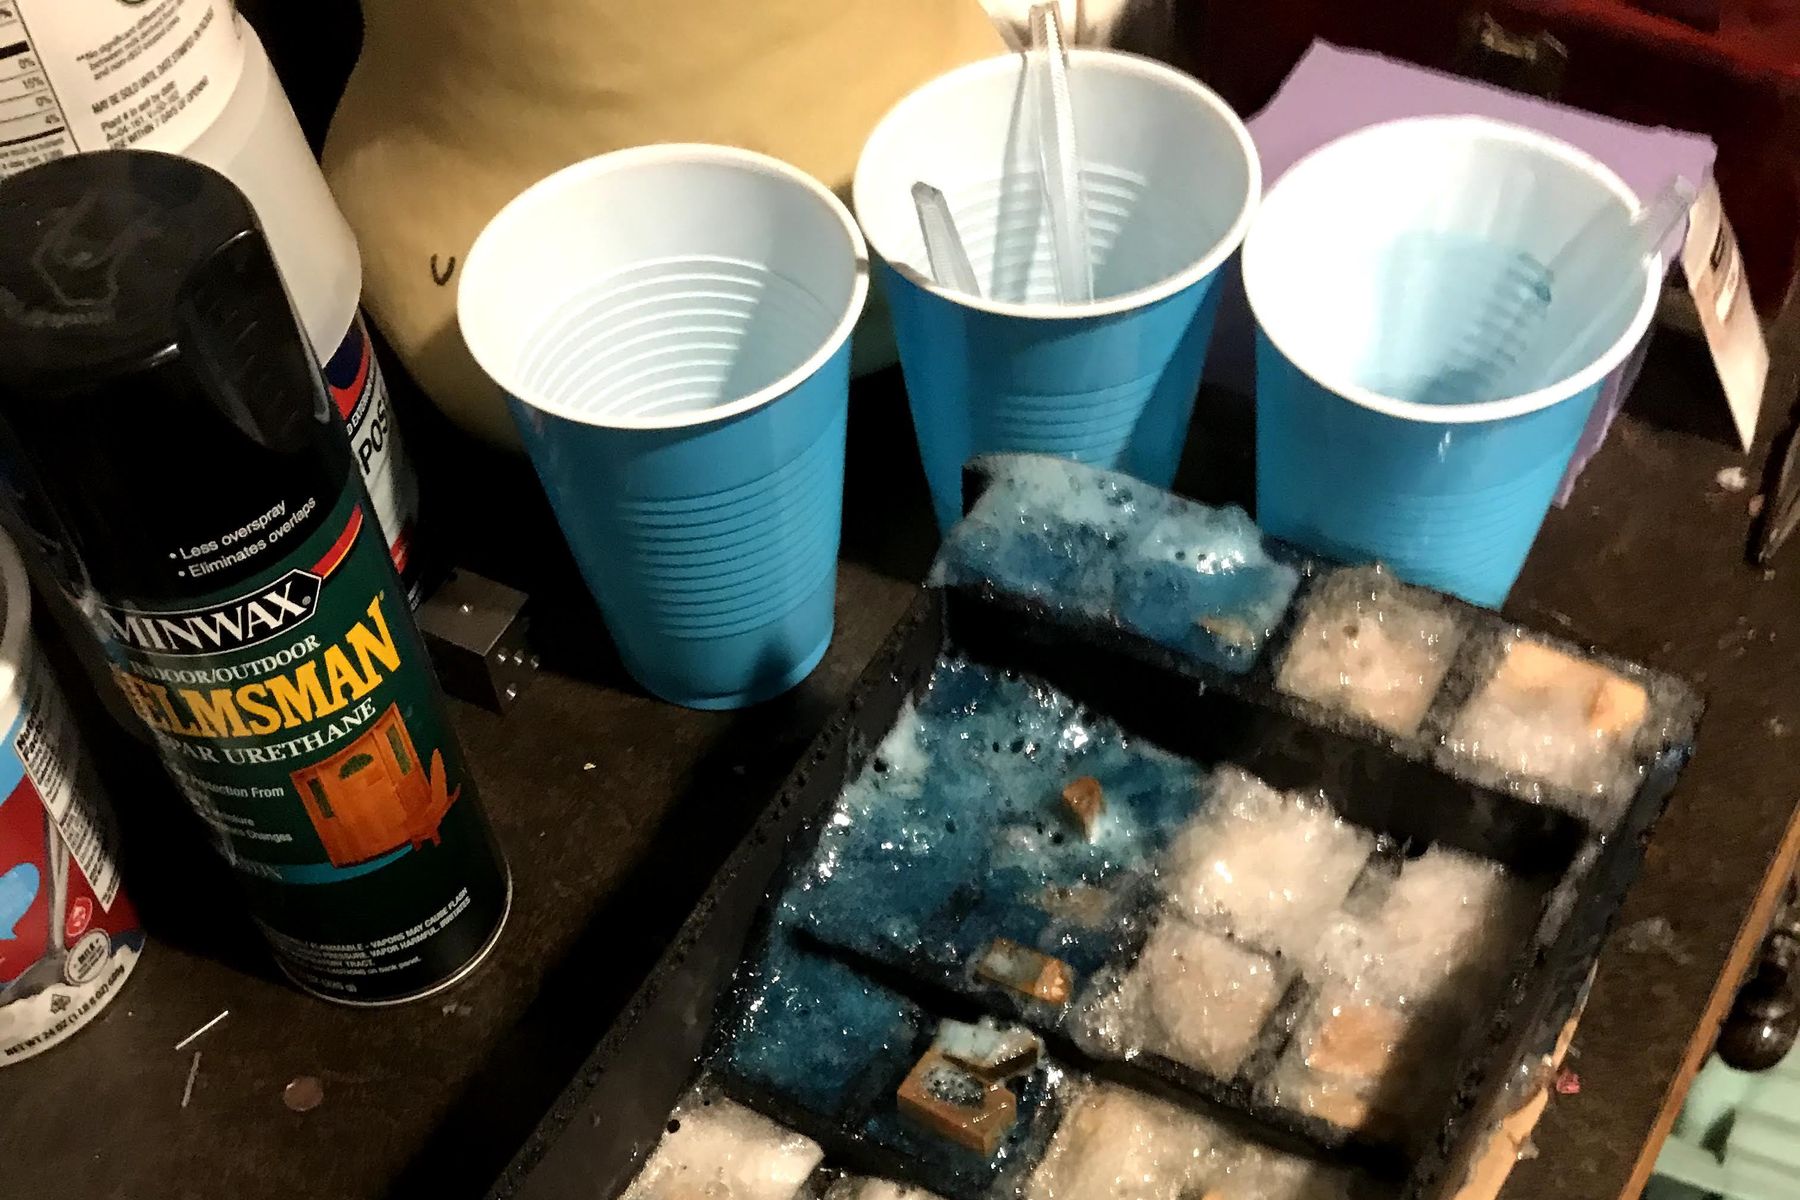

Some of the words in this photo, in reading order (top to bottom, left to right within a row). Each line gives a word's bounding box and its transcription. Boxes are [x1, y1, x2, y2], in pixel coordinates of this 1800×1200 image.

[120, 81, 139, 100] SOLD
[180, 540, 219, 560] Less
[221, 499, 286, 546] overspray
[188, 539, 267, 578] Eliminates
[269, 497, 316, 543] overlaps
[98, 581, 307, 651] MINWAX
[223, 696, 377, 765] URETHANE
[250, 786, 285, 799] From
[405, 923, 424, 939] MAY
